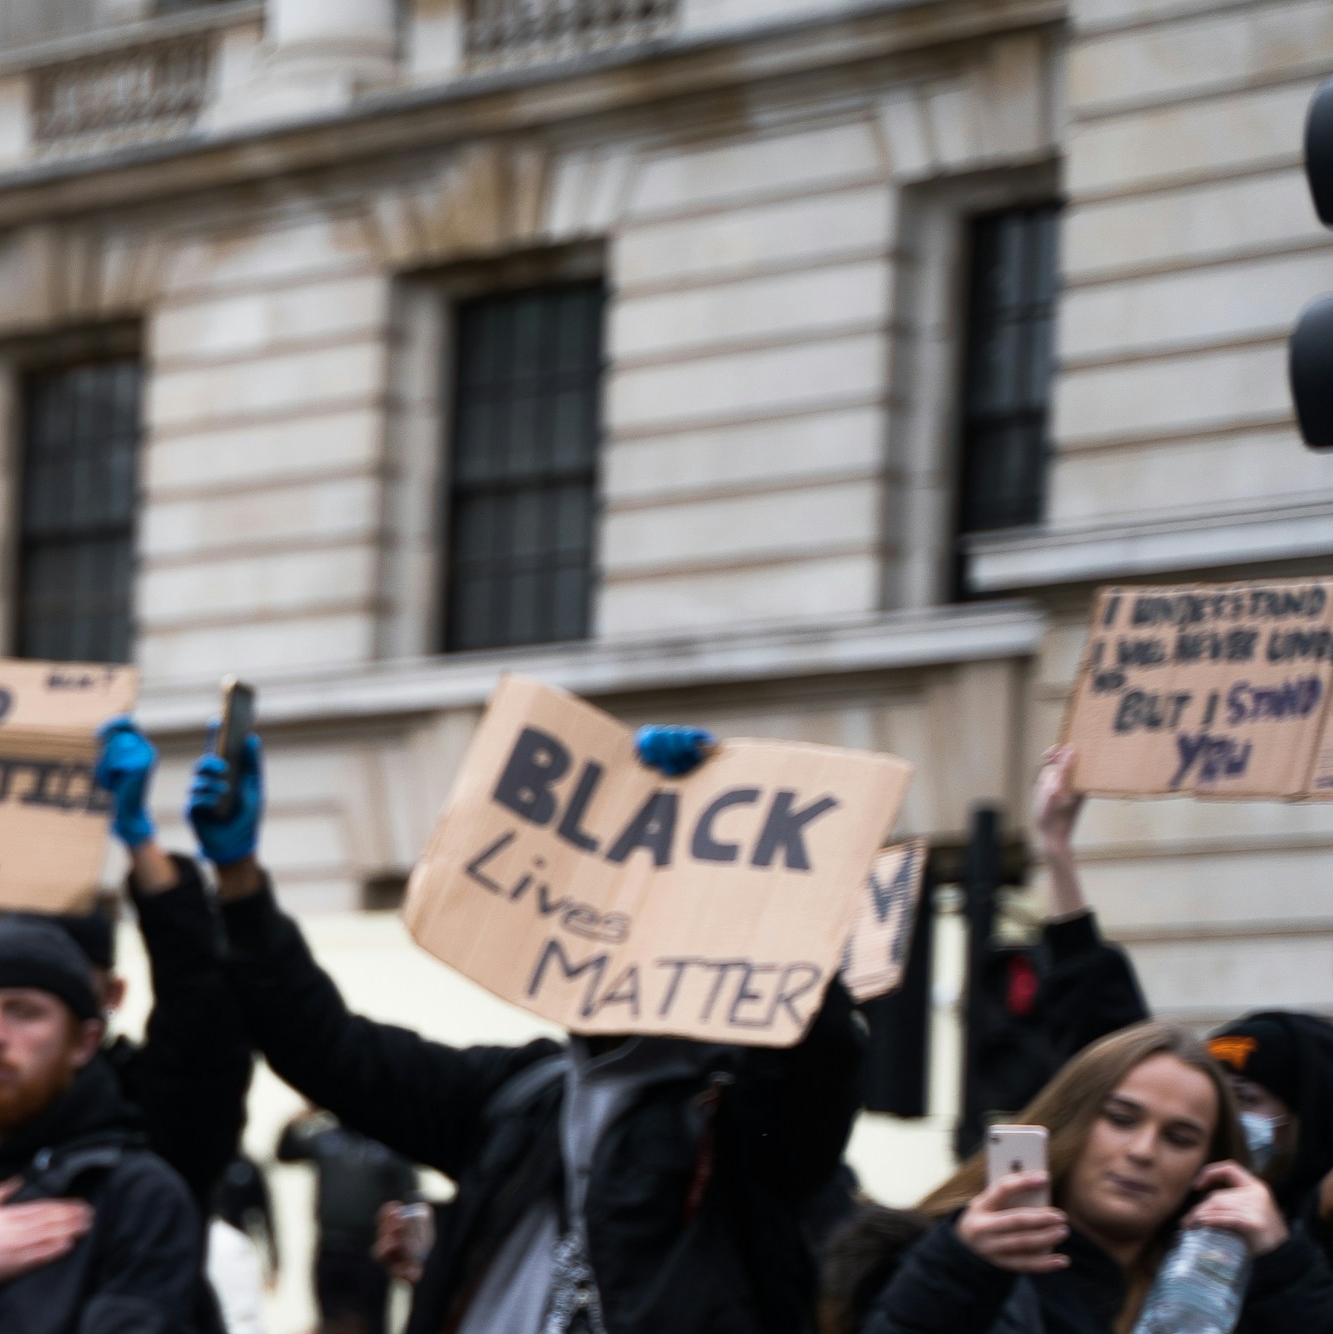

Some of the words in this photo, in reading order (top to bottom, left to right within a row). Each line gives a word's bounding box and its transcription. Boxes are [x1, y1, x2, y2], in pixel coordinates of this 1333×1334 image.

[494, 725, 838, 872] BLACK
[465, 829, 632, 945] Lives
[526, 939, 823, 1031] MATTER
